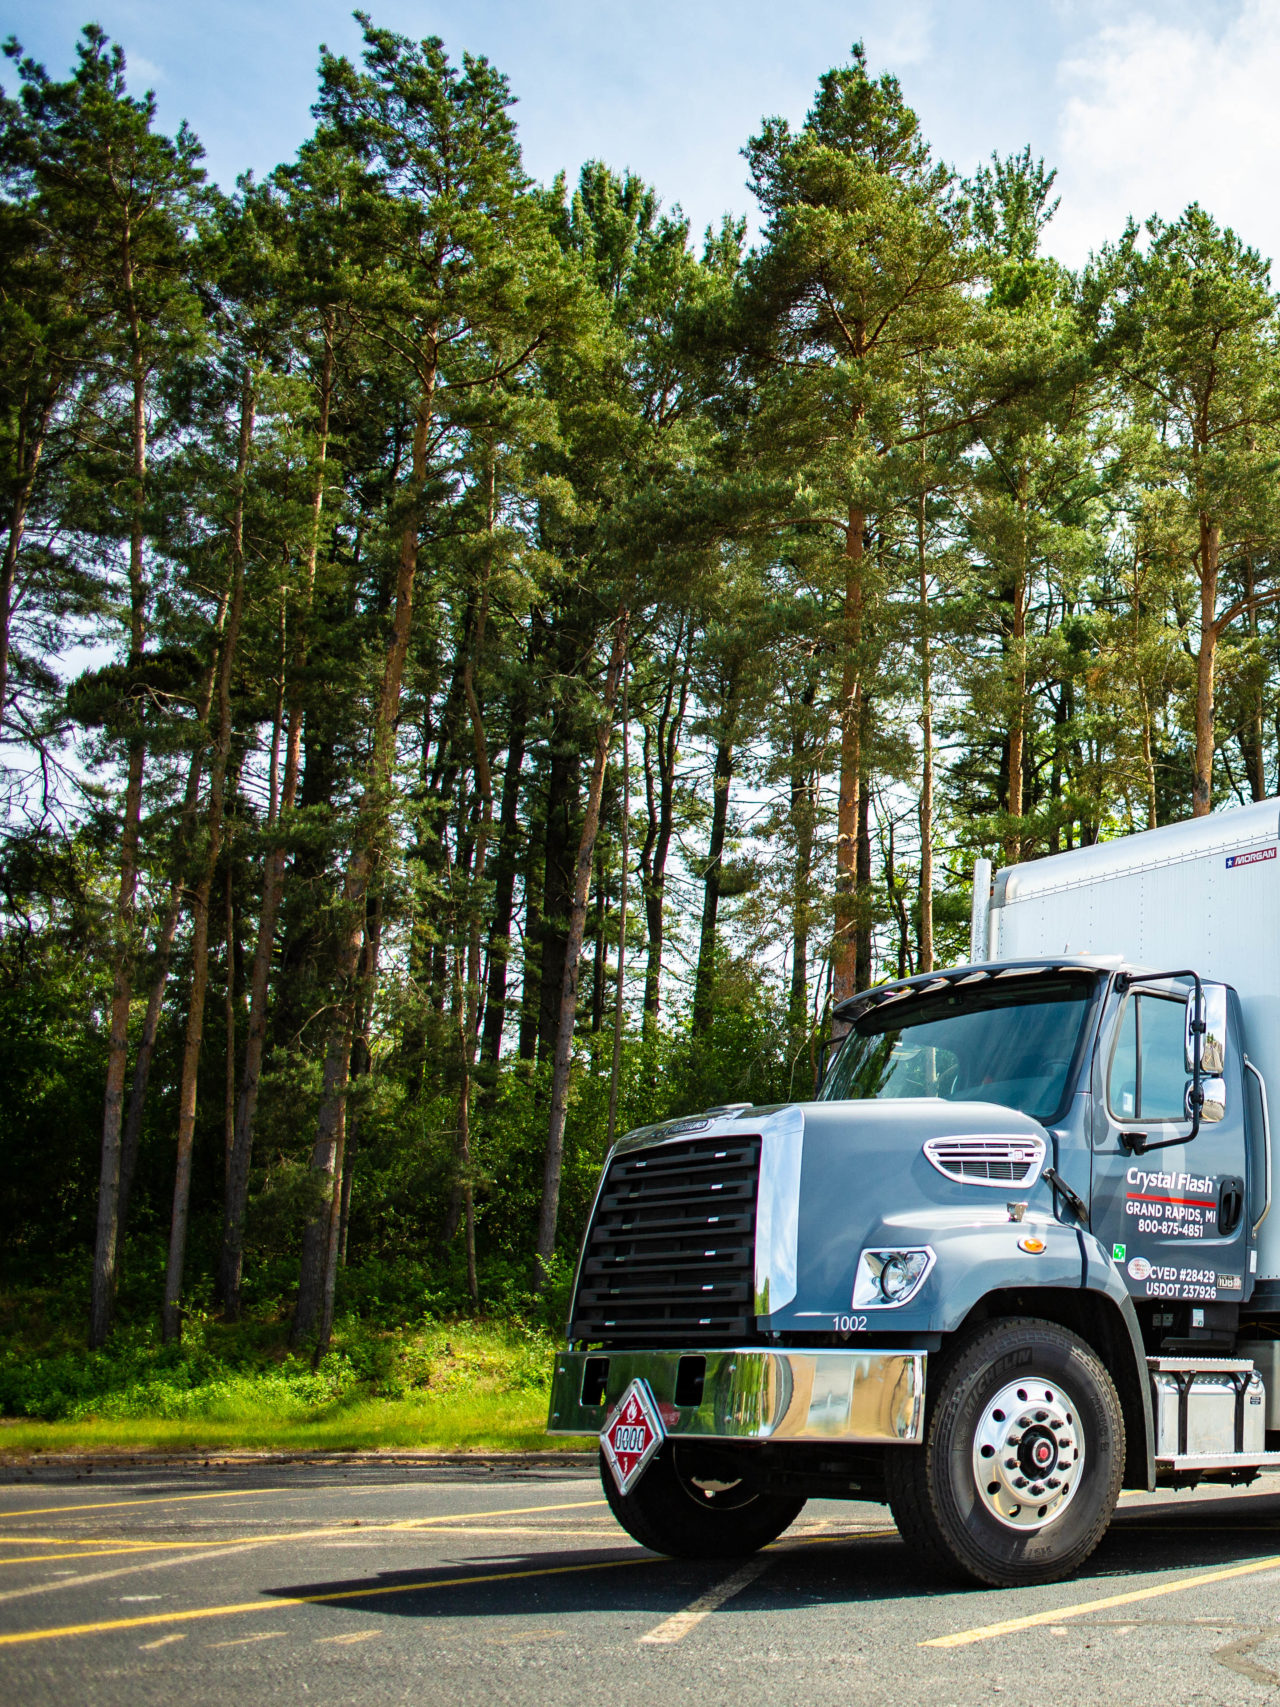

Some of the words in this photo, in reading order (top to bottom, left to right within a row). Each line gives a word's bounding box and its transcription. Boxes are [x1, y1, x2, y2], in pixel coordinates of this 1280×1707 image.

[1234, 849, 1275, 865] MORGAN
[1127, 1167, 1177, 1194] Crystal
[1177, 1173, 1214, 1194] Flash
[1125, 1201, 1163, 1218] GRAND
[1165, 1205, 1203, 1224] RAPIDS,
[1205, 1209, 1216, 1224] MI
[1138, 1218, 1204, 1238] 800-875-4851
[1179, 1268, 1216, 1283] #28429
[1146, 1281, 1180, 1296] USDOT
[1182, 1284, 1217, 1299] 237926
[832, 1315, 867, 1331] 1002
[962, 1347, 1032, 1419] MICHELIN
